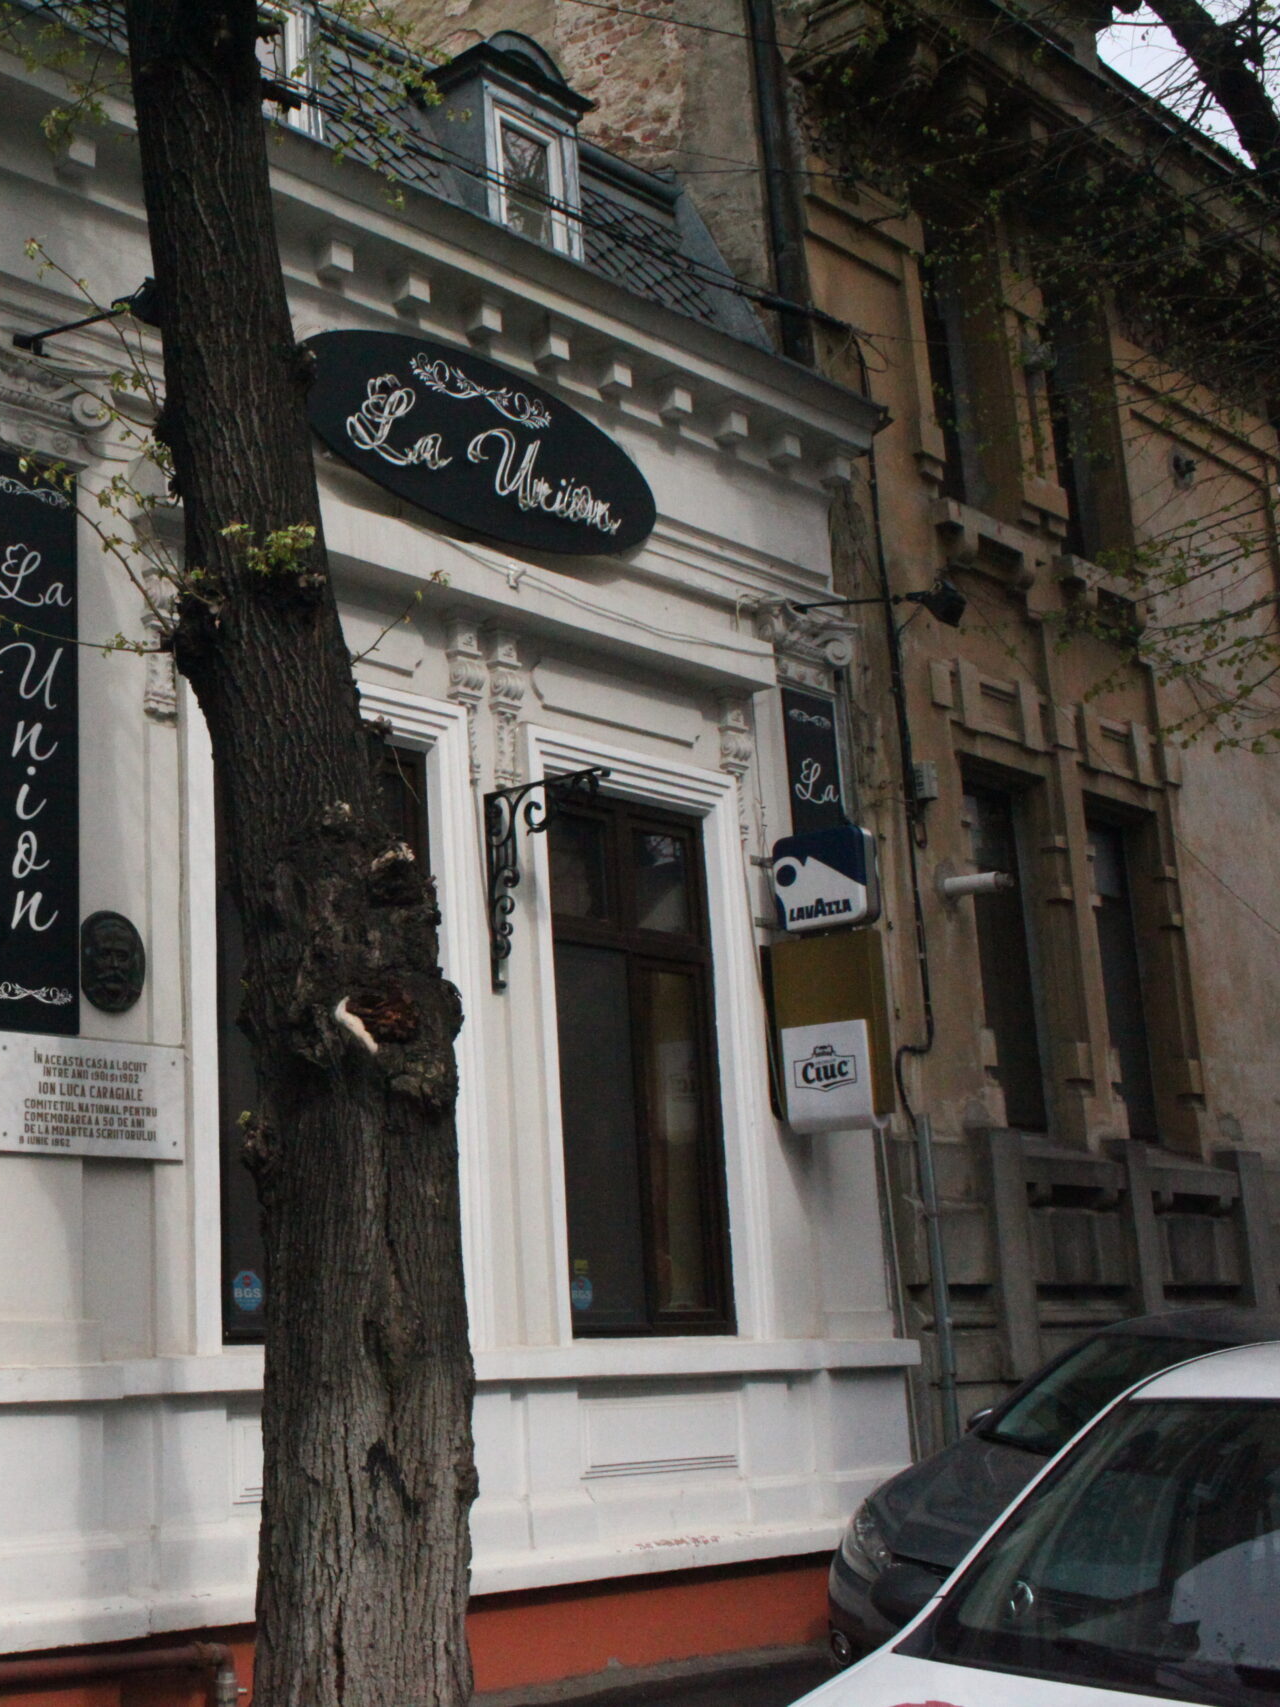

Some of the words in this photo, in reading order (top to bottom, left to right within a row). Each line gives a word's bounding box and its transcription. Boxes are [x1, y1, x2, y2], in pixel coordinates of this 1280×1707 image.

[346, 374, 452, 470] La
[795, 758, 840, 804] La
[789, 898, 853, 922] LAVAZZA
[116, 1060, 147, 1072] LOCUIT
[802, 1060, 849, 1084] Ciuc
[38, 1081, 56, 1095] ION
[60, 1083, 86, 1098] LUCA
[89, 1085, 143, 1101] CARAGIALE
[24, 1098, 76, 1112] COMITETUL
[123, 1106, 157, 1117] PENTRU
[24, 1111, 92, 1125] COMEMORAREA
[94, 1116, 100, 1126] A
[103, 1116, 114, 1127] 50
[117, 1118, 128, 1128] DE
[131, 1118, 145, 1129] ANI
[24, 1123, 35, 1134] DE
[38, 1124, 49, 1135] LA
[51, 1125, 94, 1138] MOARTEA
[27, 1136, 48, 1146] IUNIE
